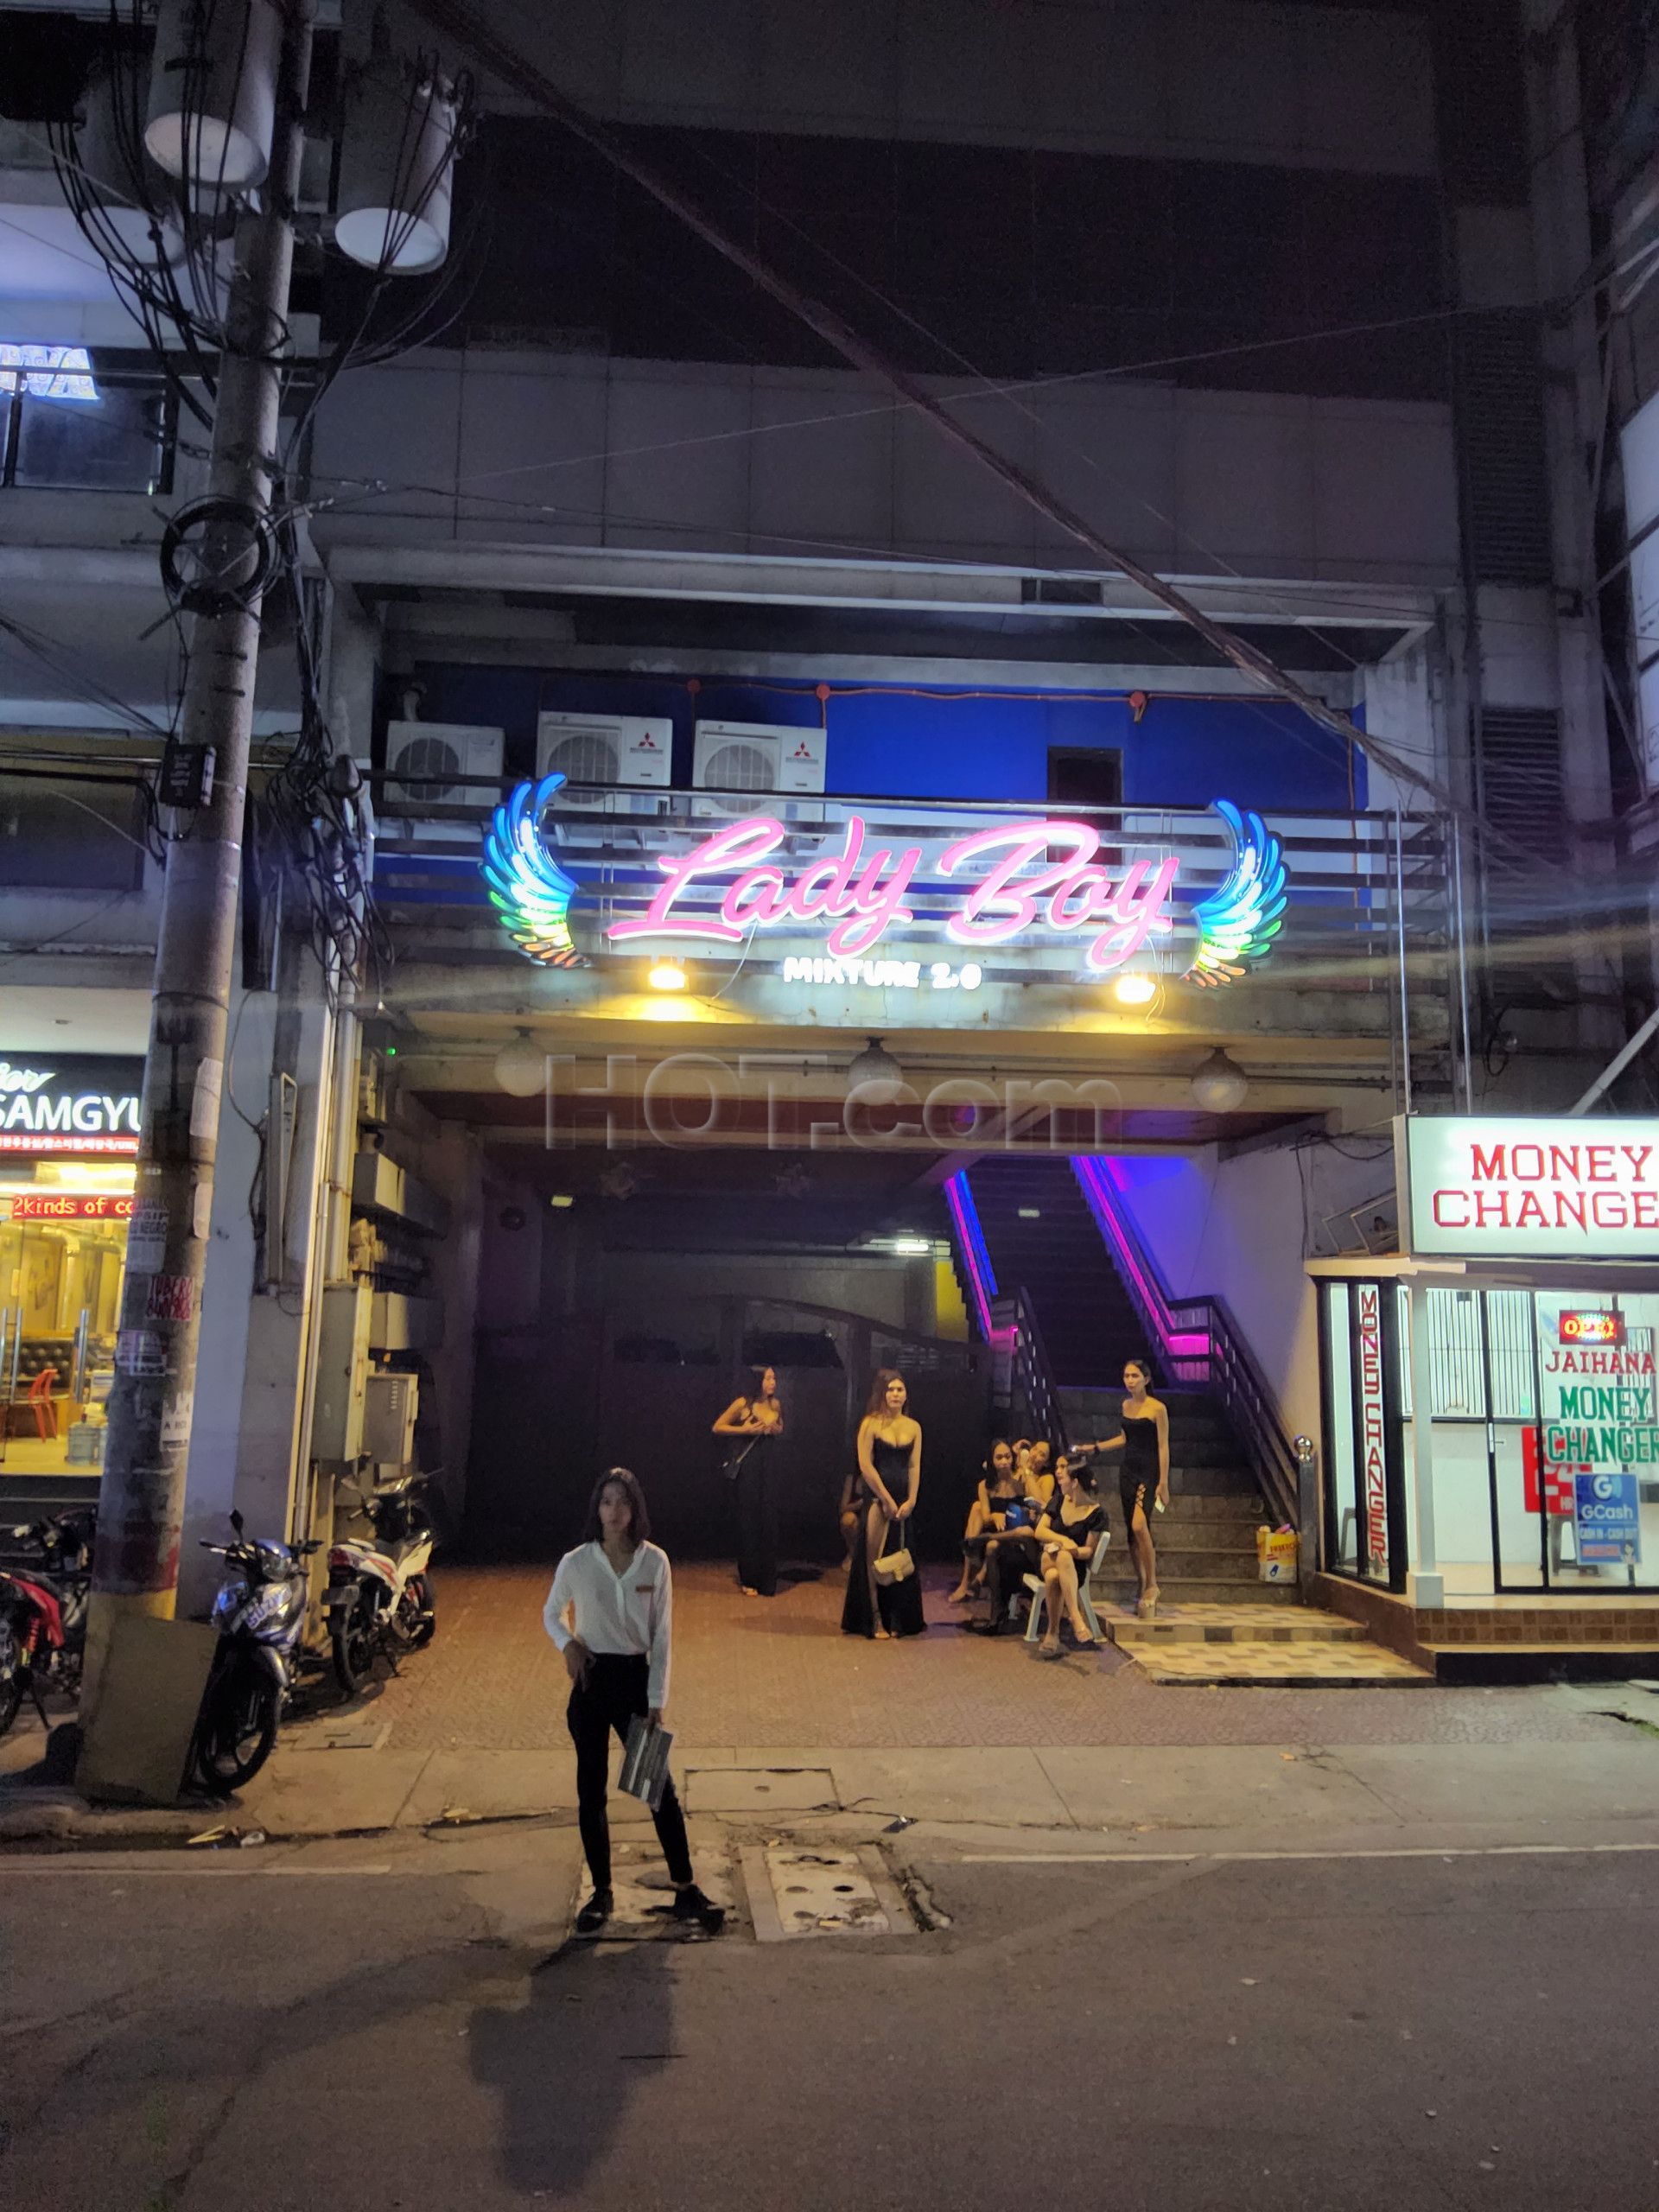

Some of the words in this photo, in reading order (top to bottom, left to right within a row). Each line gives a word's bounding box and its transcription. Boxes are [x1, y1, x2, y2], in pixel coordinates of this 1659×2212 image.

[608, 815, 922, 958] Lady
[936, 821, 1179, 971] Boy
[784, 957, 921, 988] MIXTURE
[931, 962, 982, 990] 2.0
[0, 1094, 142, 1132] AMGY
[1471, 1144, 1653, 1184] MONEY
[84, 1197, 108, 1214] of
[1433, 1190, 1659, 1236] CHANGE
[1361, 1290, 1381, 1395] MONEY
[1545, 1351, 1656, 1374] JAIHANA
[1559, 1386, 1650, 1424] MONEY
[1548, 1426, 1659, 1465] CHANGER
[1364, 1402, 1389, 1566] CHANGER
[1581, 1503, 1633, 1520] GCash
